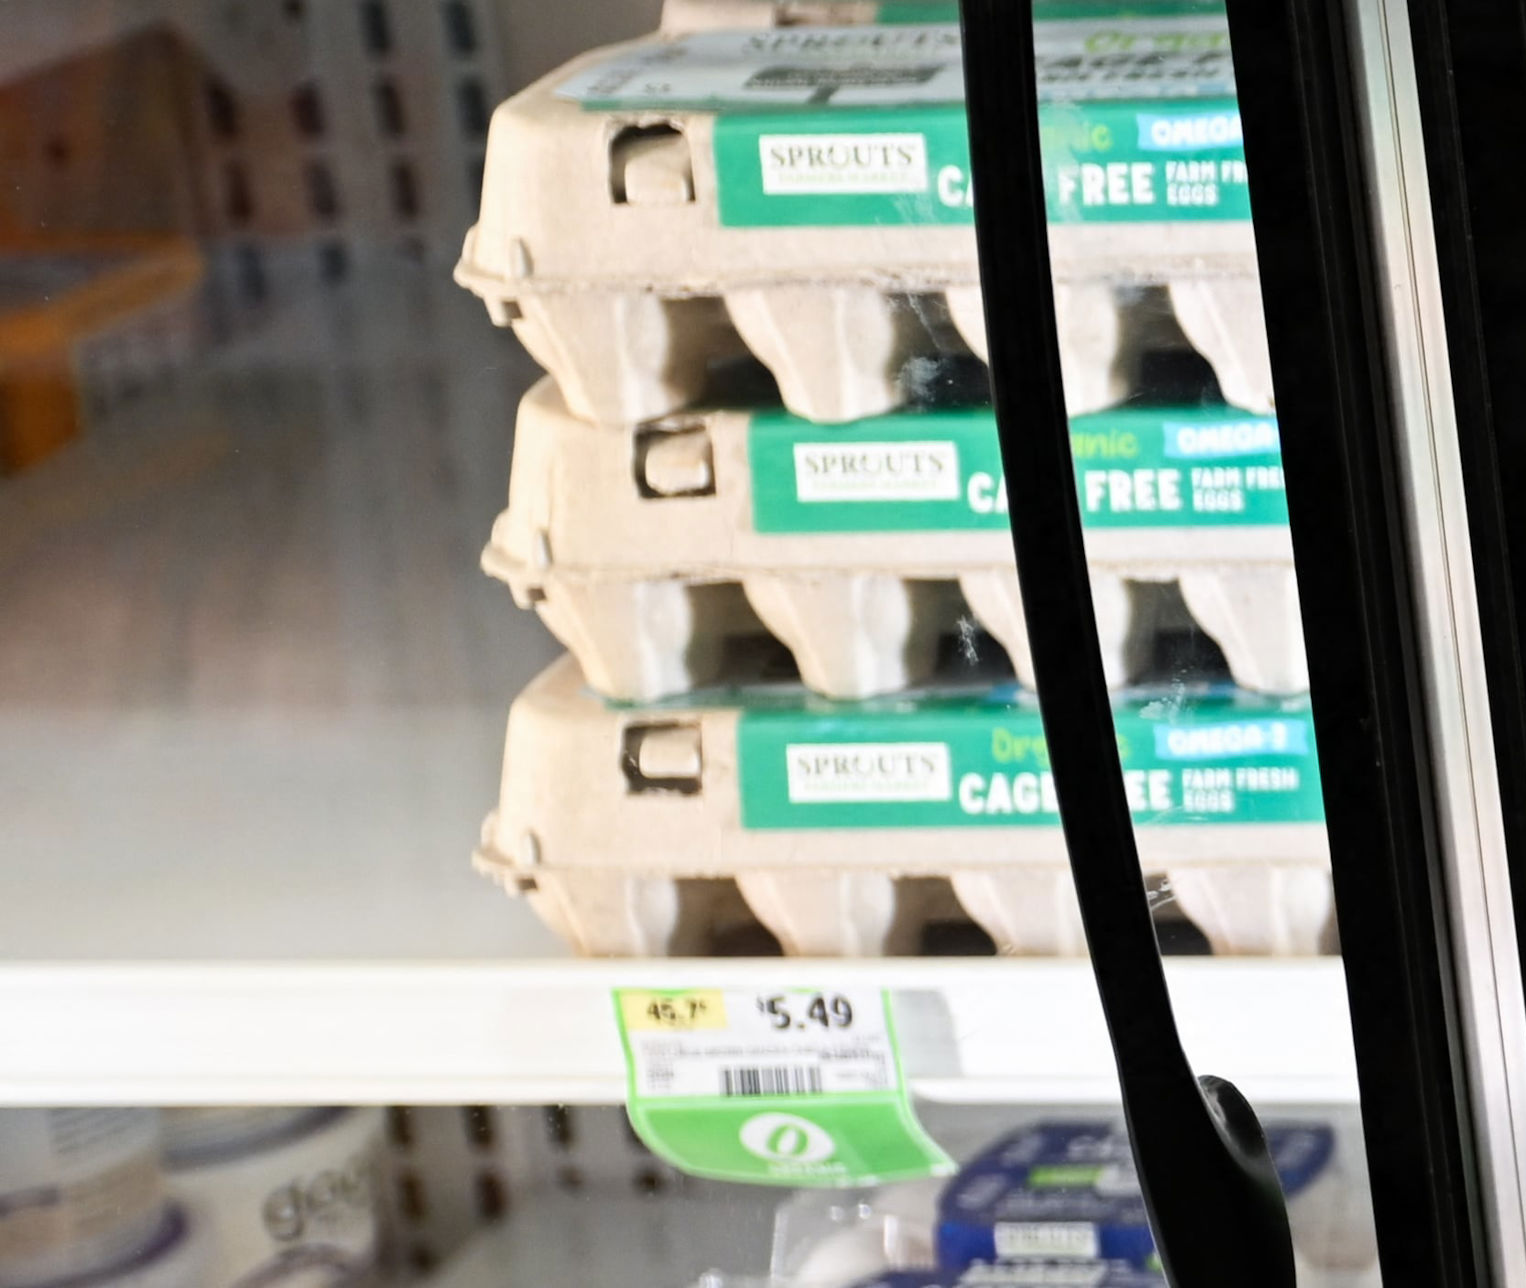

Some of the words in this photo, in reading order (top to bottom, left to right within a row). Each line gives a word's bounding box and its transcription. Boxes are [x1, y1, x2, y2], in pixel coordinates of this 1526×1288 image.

[770, 144, 917, 169] SPROUTS
[1058, 161, 1155, 206] FREE
[1166, 183, 1219, 206] EGGS
[804, 450, 946, 474] SPROUTS
[1085, 469, 1182, 512] FREE
[796, 753, 937, 778] SPROUTS
